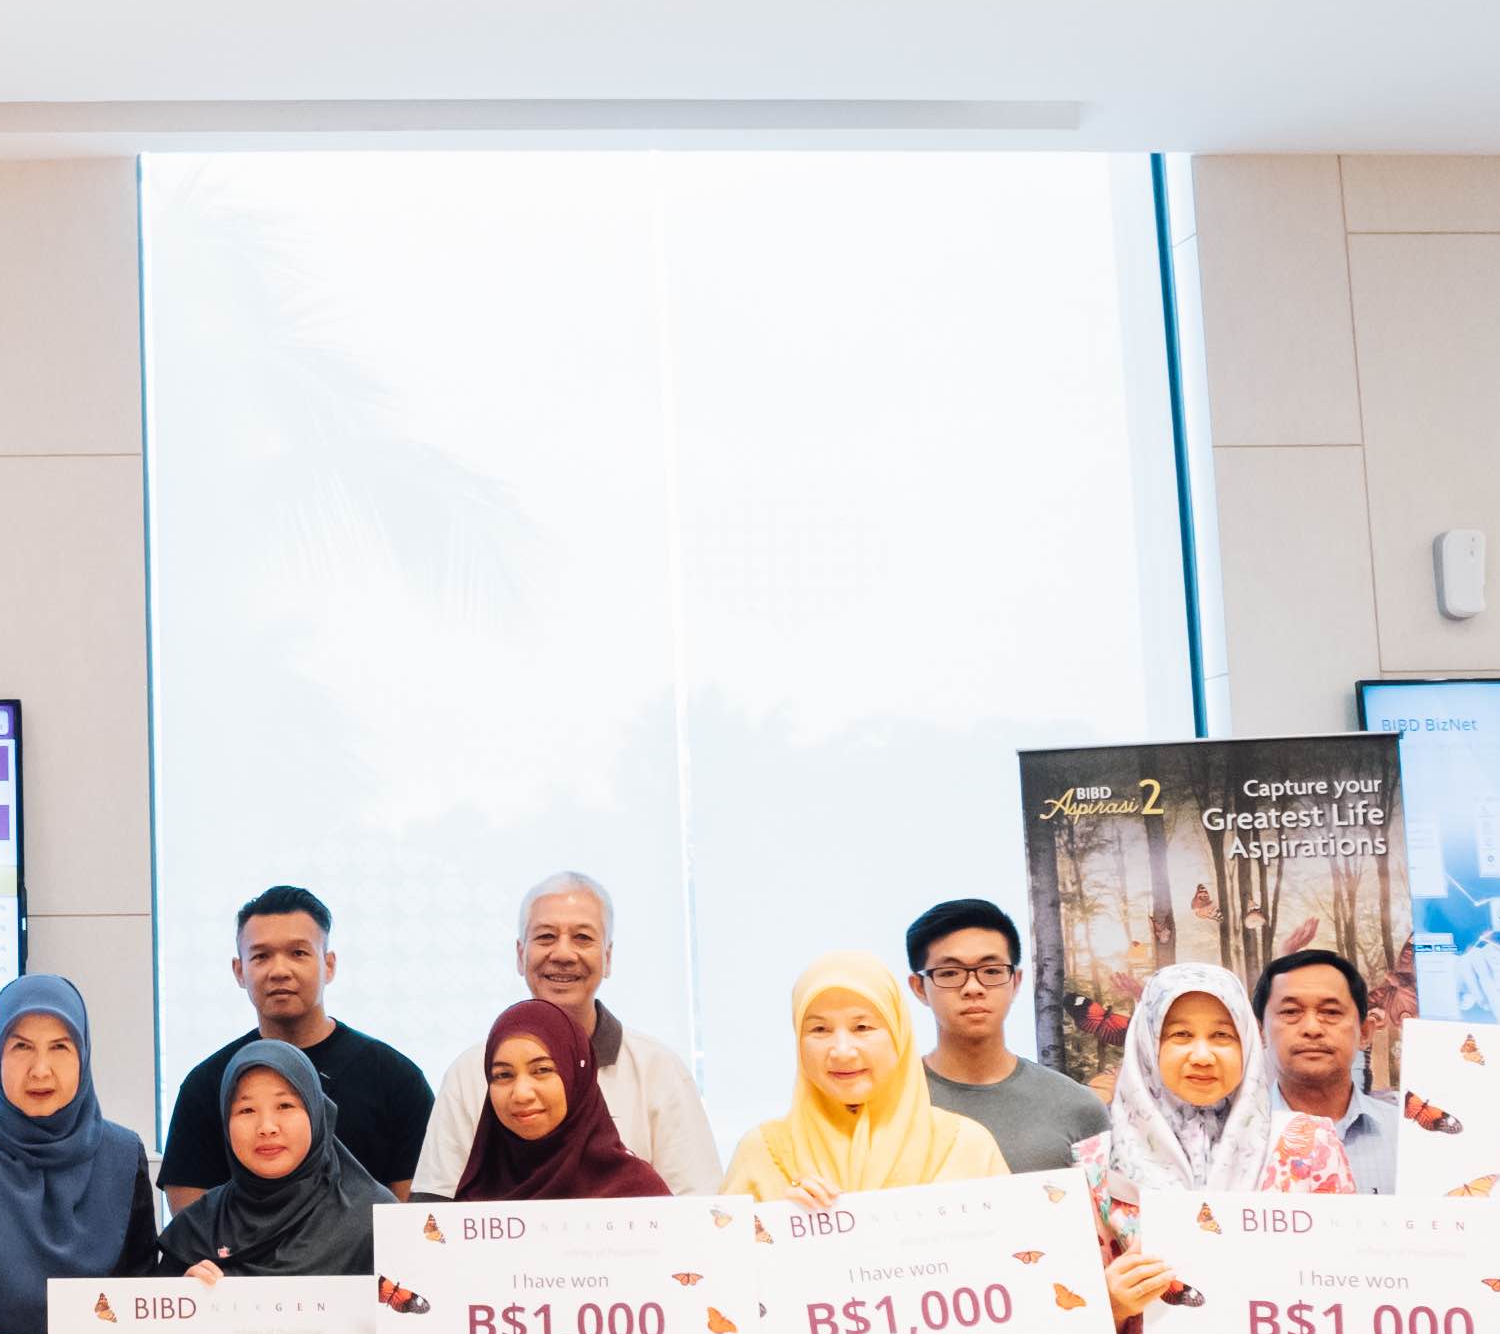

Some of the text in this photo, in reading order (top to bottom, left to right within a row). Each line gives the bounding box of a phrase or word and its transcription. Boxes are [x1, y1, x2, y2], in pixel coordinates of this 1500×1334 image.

[1381, 718, 1478, 732] BIBD BizNet
[1040, 778, 1164, 823] Aspirasi 2
[1076, 786, 1112, 801] BIBD
[1242, 778, 1382, 802] Capture your
[1202, 802, 1384, 833] Greatest Life
[1227, 833, 1387, 865] Aspirations
[464, 1216, 525, 1240] BIBD
[789, 1210, 855, 1238] BIBD
[1243, 1209, 1312, 1233] BIBD
[524, 1273, 608, 1289] have won
[859, 1261, 949, 1282] have won
[1312, 1270, 1408, 1289] have won
[135, 1297, 196, 1319] BIBD
